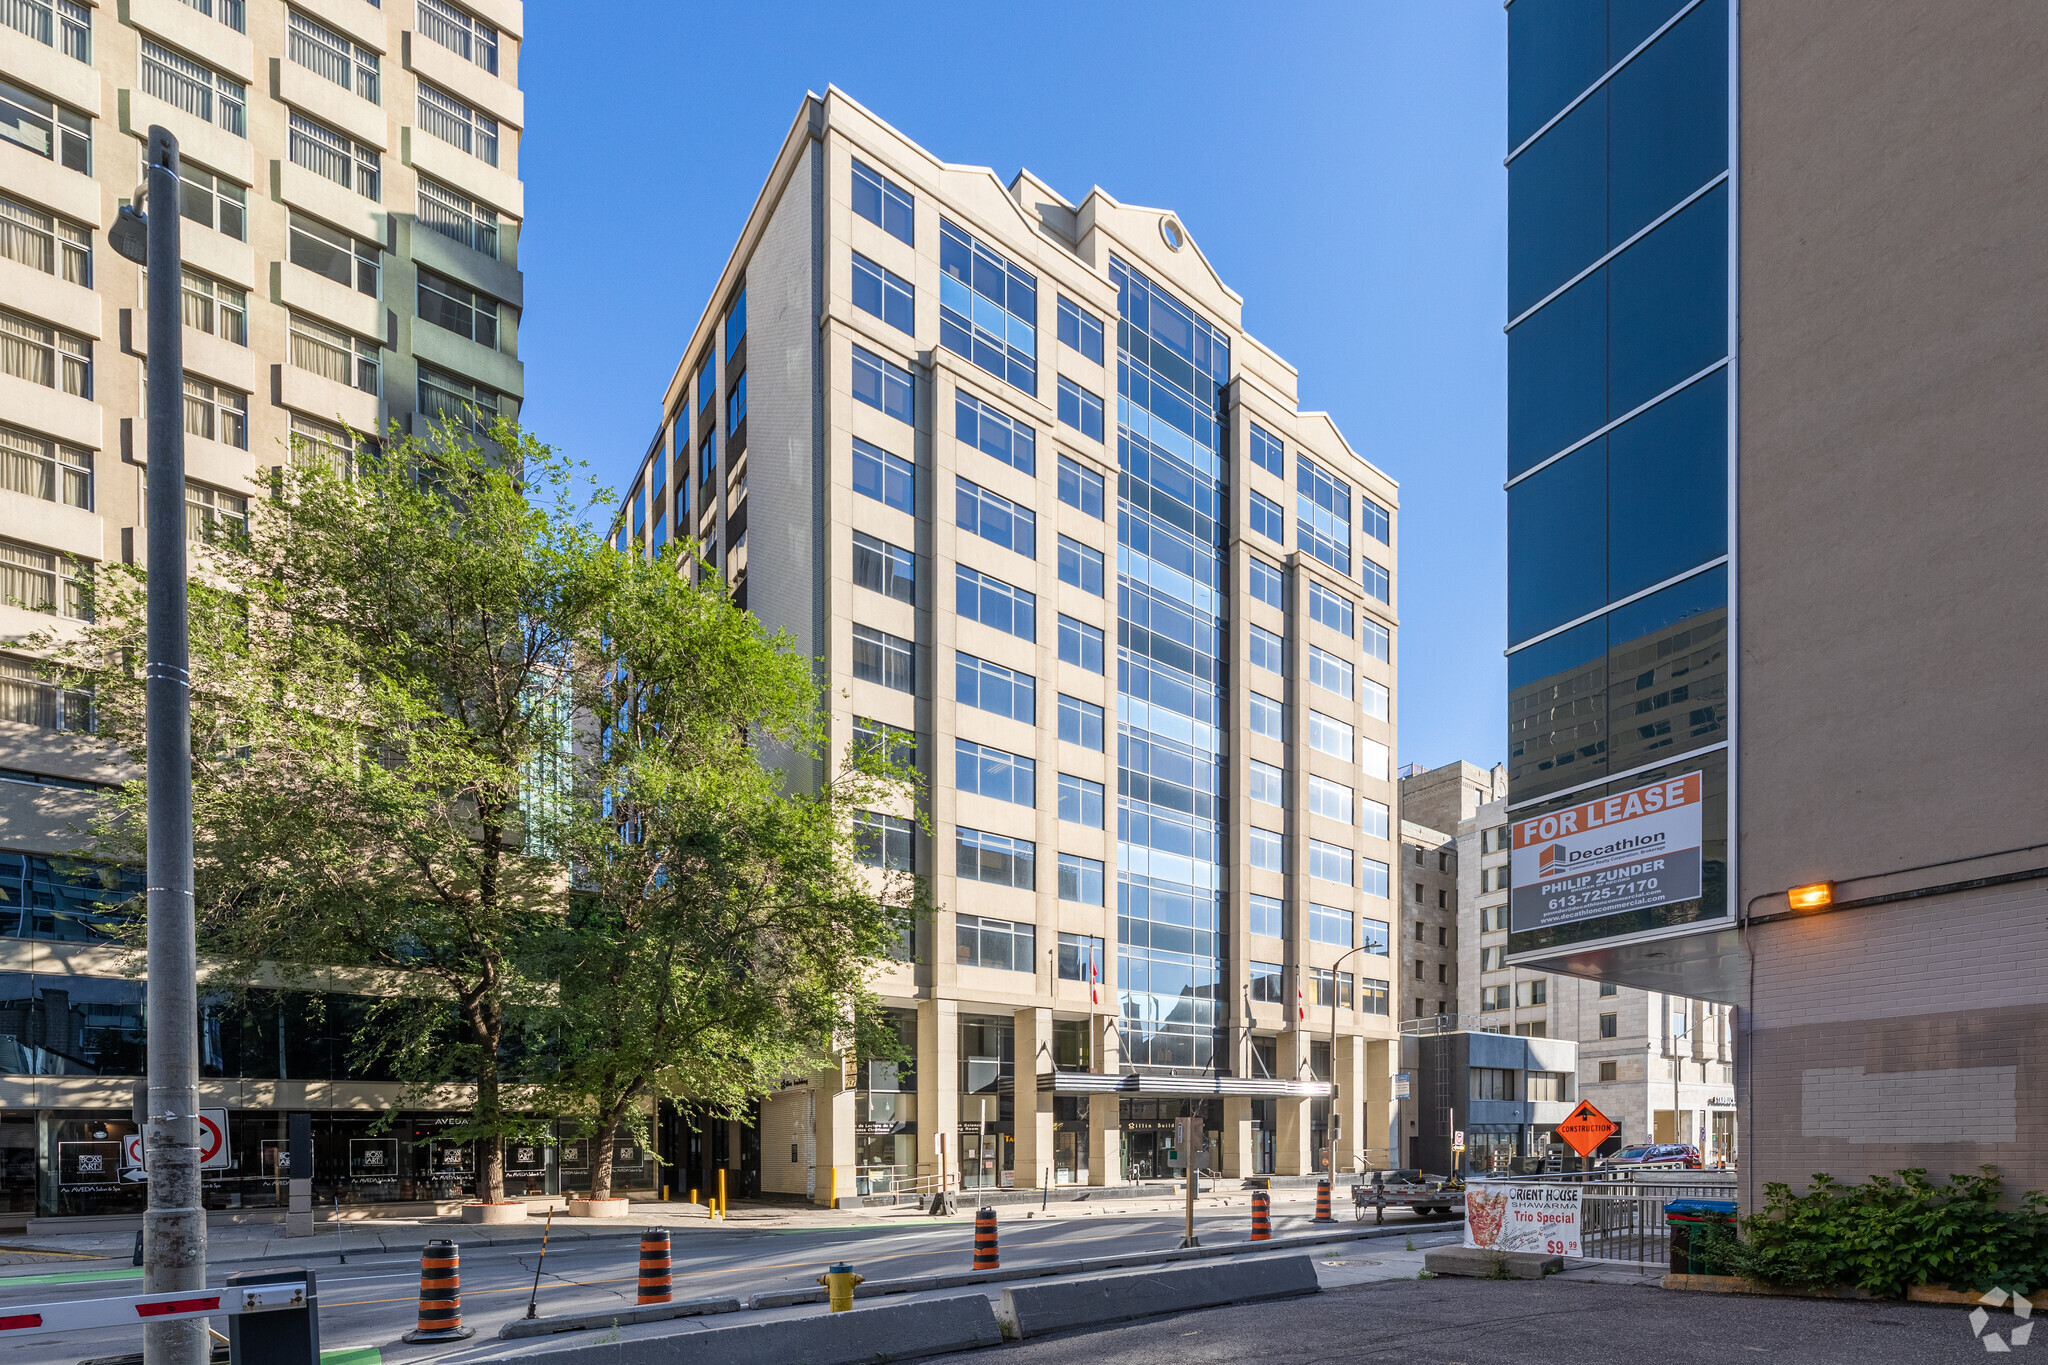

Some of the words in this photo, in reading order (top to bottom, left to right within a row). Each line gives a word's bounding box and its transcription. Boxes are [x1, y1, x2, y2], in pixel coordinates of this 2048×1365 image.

[1523, 811, 1578, 846] FOR
[1587, 780, 1684, 826] LEASE
[1569, 832, 1665, 862] Decathlon
[1542, 876, 1591, 896] PHILIP
[1596, 859, 1665, 883] ZUNDER
[1571, 884, 1595, 893] BROKER
[1548, 878, 1658, 910] 613-725-7170
[1540, 895, 1665, 924] www.decathloncommercial.com
[1509, 1188, 1543, 1201] ORIENT
[1546, 1189, 1578, 1201] HOUSE
[1514, 1211, 1533, 1222] Trio
[1537, 1211, 1574, 1225] Special
